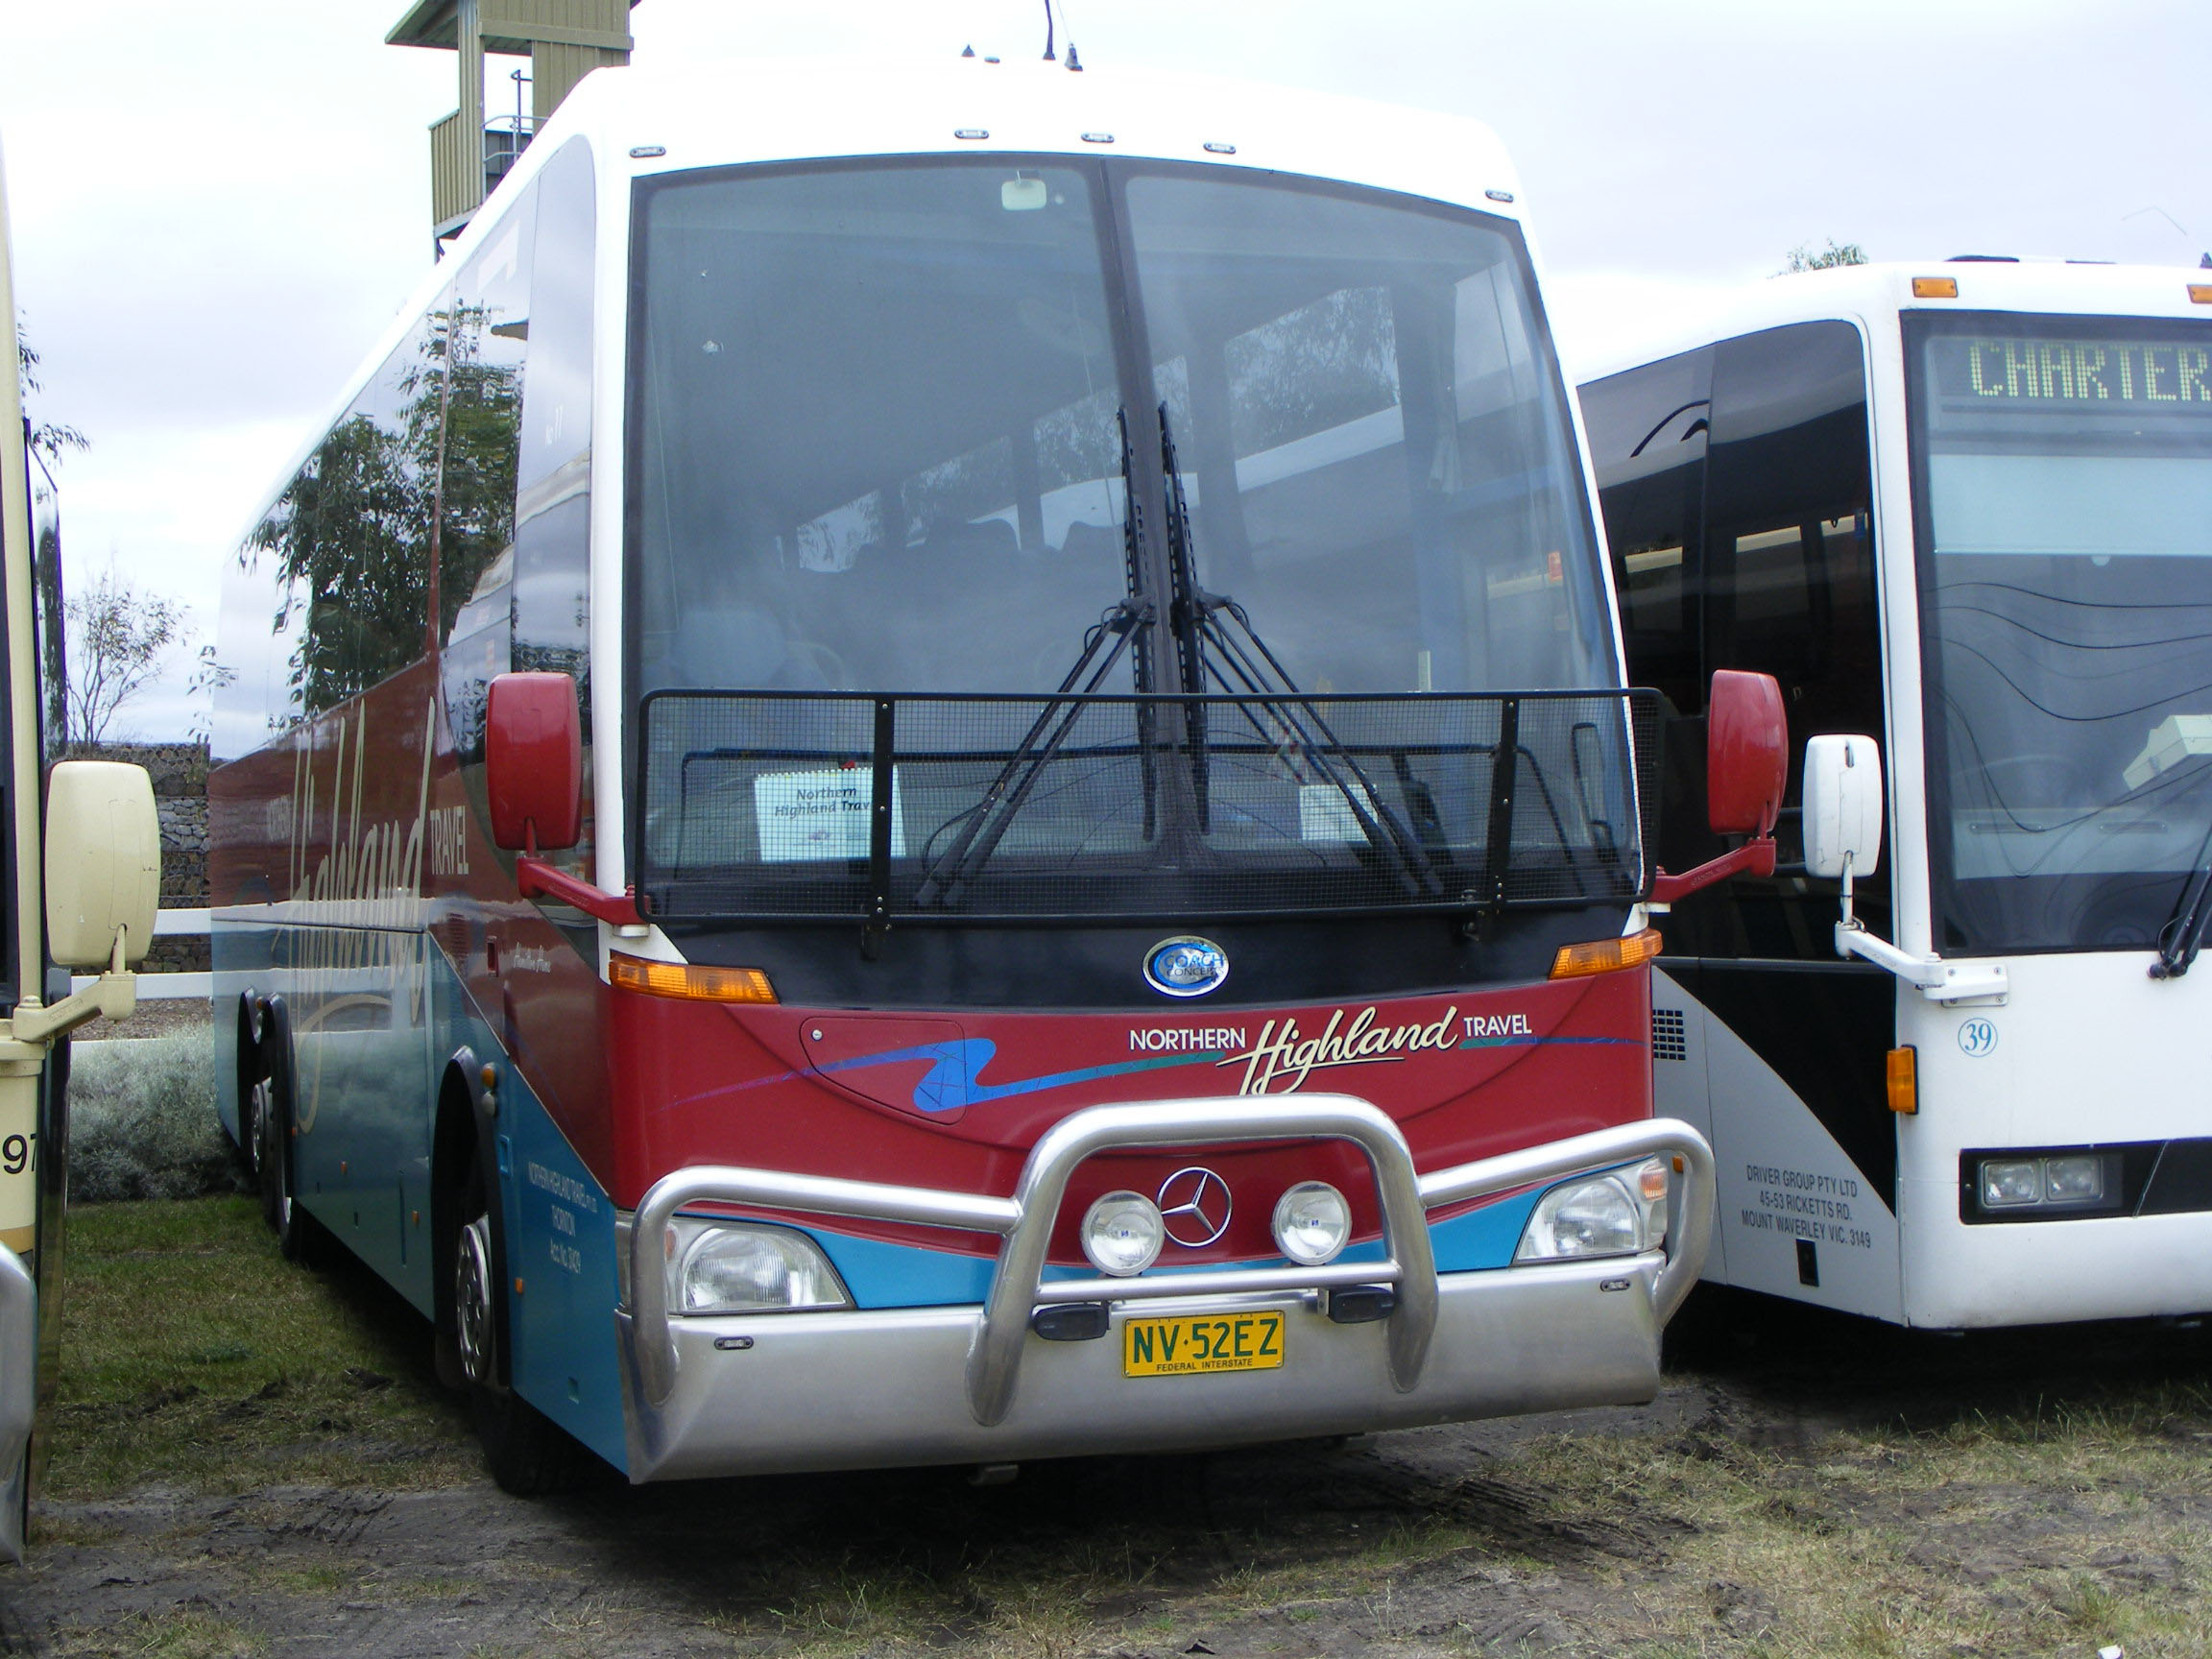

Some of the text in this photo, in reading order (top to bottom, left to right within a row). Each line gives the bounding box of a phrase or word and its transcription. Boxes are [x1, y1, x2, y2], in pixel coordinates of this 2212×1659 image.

[1970, 342, 2212, 401] CHARTER
[797, 785, 857, 801] Northern
[775, 801, 871, 820] Highland Trav
[430, 805, 469, 876] TRAVEL
[1164, 953, 1224, 969] COACH
[1128, 1005, 1533, 1095] NORTHERN Highland TRAVEL
[1964, 1022, 1992, 1052] 39
[1745, 1164, 1858, 1198] DRIVER GROUP PTY LTD
[1759, 1190, 1853, 1221] 45-53 RICKETTS RD.
[1742, 1209, 1871, 1248] MOUNT WAVERLEY VIC. 3149
[1156, 1358, 1253, 1372] FEDERAL INTERSTATE
